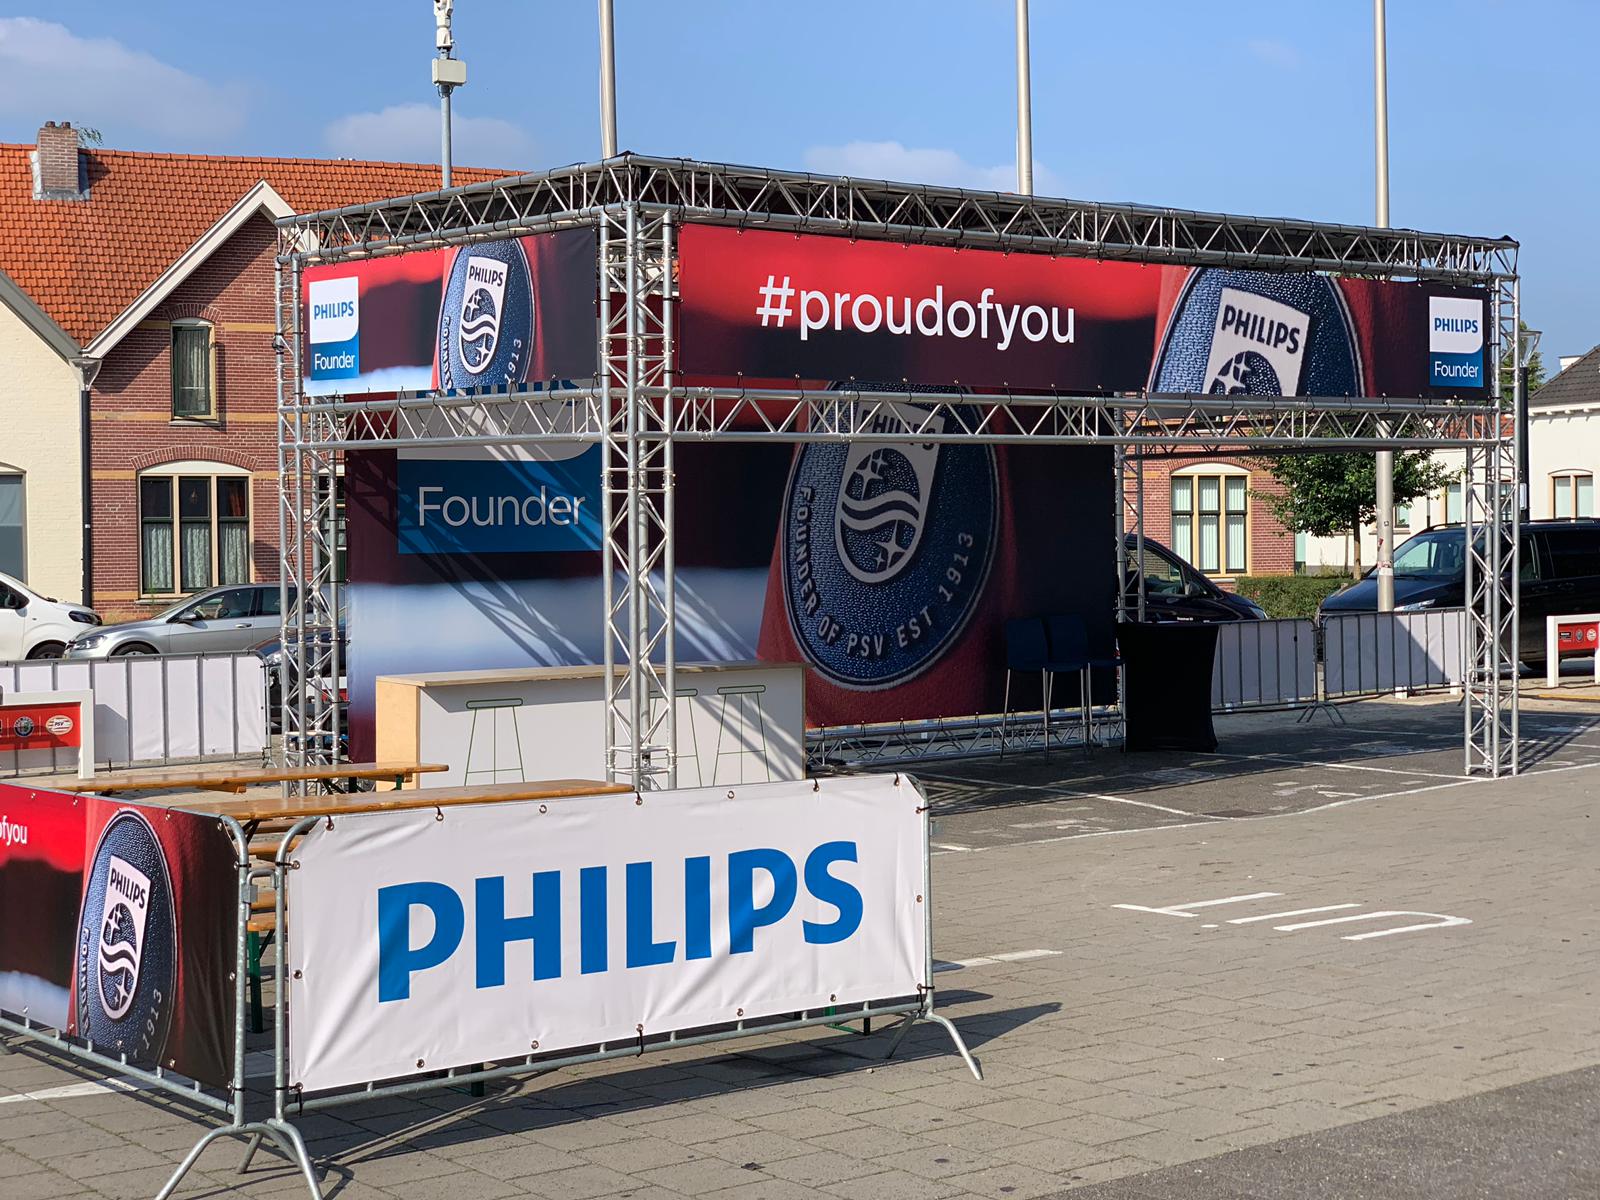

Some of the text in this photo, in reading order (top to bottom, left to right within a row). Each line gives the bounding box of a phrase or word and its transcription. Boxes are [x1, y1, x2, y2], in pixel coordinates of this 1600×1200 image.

[469, 265, 503, 287] PHILIPS
[313, 301, 355, 320] PHILIPS
[755, 275, 1075, 350] #proudofyou
[1221, 304, 1301, 354] PHILIPS
[1434, 317, 1478, 334] PHILIPS
[314, 350, 355, 371] Founder
[505, 338, 522, 384] 1913
[1434, 360, 1479, 378] Founder
[861, 409, 936, 450] PHIS
[418, 485, 586, 527] Founder
[794, 486, 974, 657] FOUNDER OF PSV EST 1913
[0, 815, 28, 847] fyou
[110, 868, 146, 909] PHILIPS
[377, 840, 864, 1003] PHILIPS
[143, 988, 162, 1050] 1913
